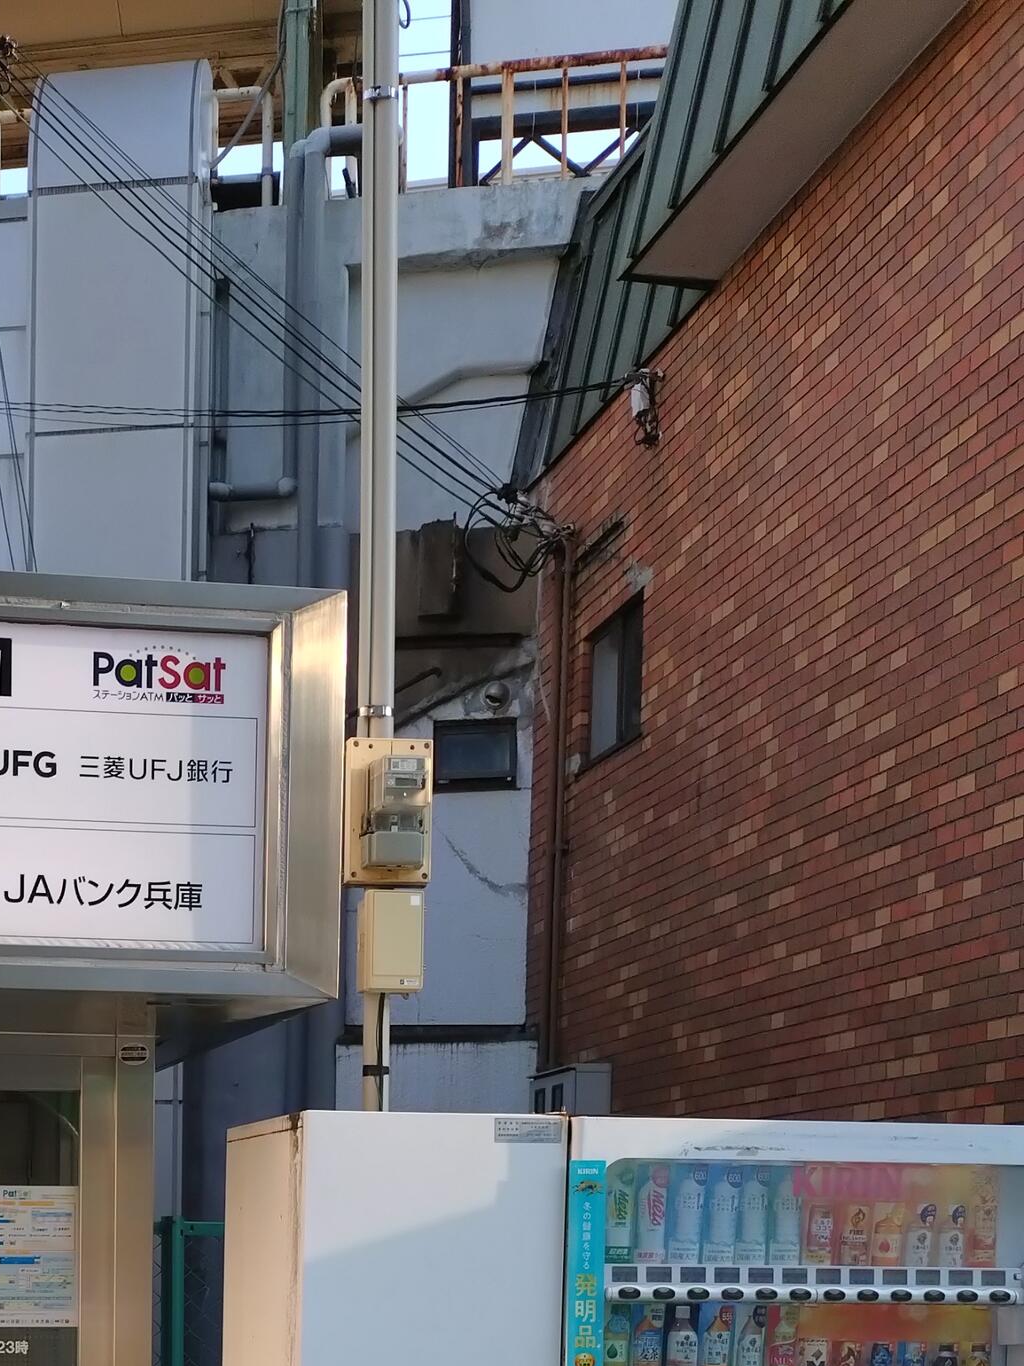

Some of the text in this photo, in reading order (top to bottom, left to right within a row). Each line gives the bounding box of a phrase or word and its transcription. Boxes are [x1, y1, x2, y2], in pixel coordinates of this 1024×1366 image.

[93, 651, 226, 692] PatSat
[93, 690, 164, 702] ステーションATM
[79, 755, 233, 783] 三菱UFJ銀行
[4, 874, 203, 911] JAバンク兵庫
[577, 1167, 599, 1175] KIRIN
